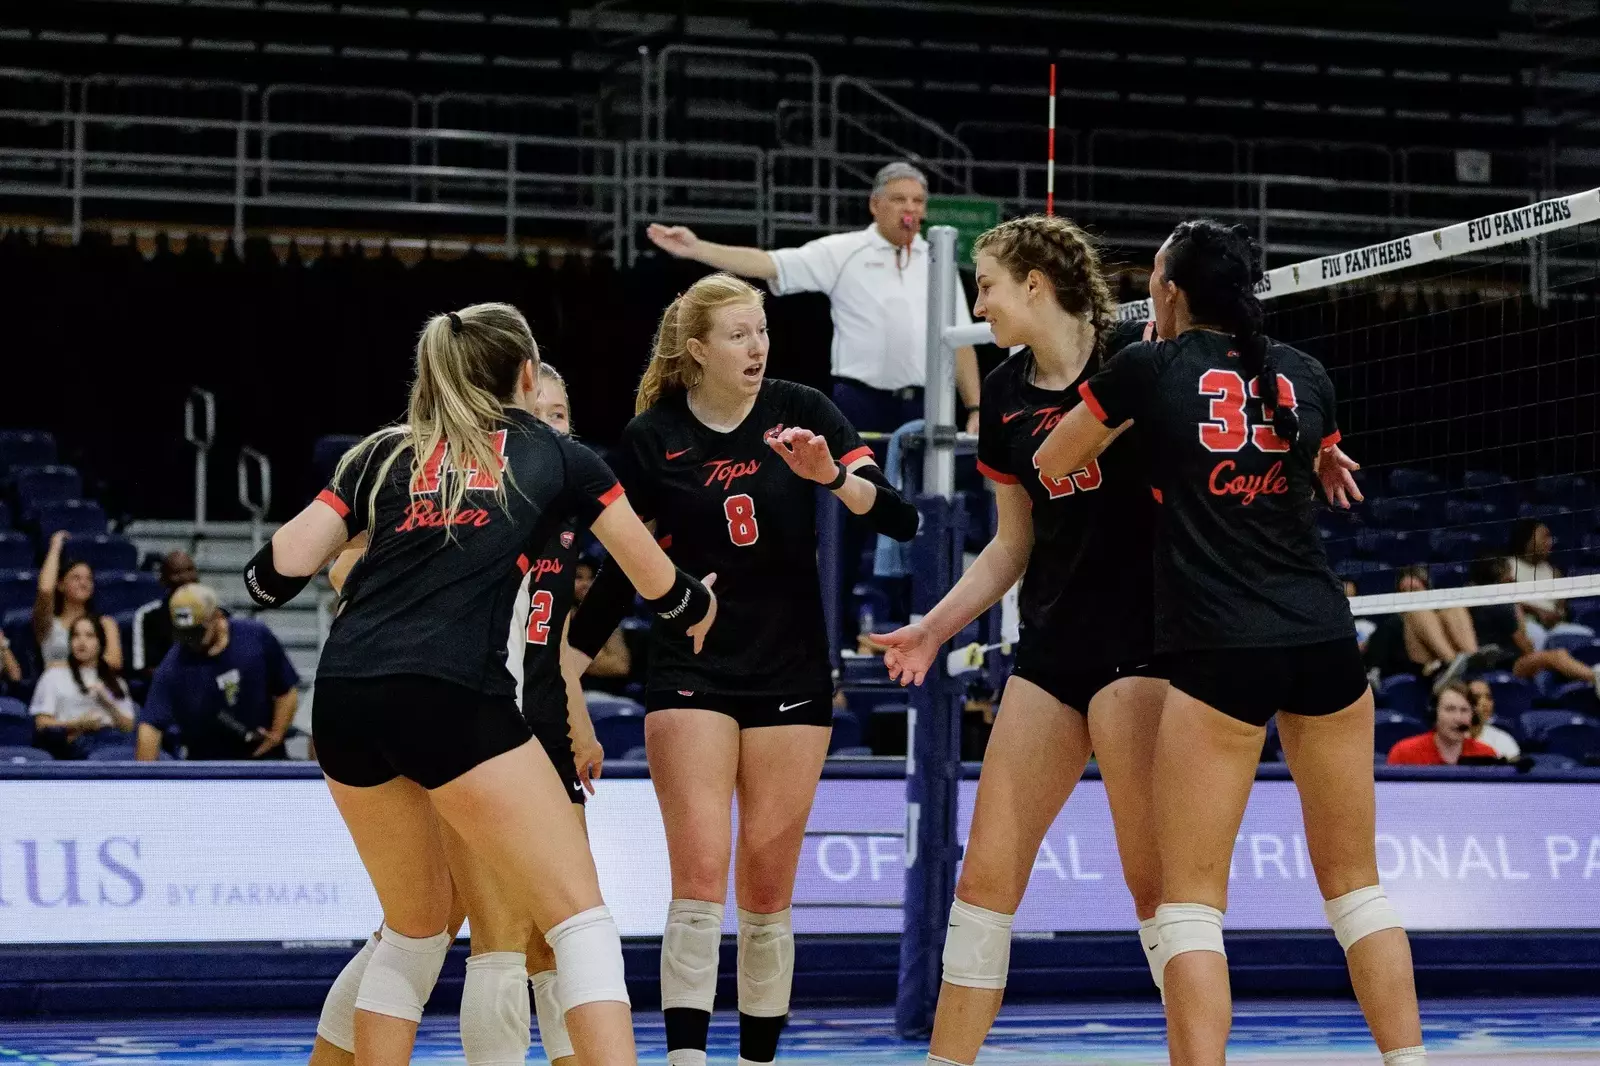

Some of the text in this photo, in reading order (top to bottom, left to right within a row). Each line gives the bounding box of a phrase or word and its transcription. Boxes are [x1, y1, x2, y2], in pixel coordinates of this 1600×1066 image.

[1467, 199, 1571, 243] FIU PANTHERS
[1321, 238, 1412, 279] FIU PANTHERS
[1031, 405, 1069, 436] To
[1199, 369, 1299, 452] 33
[702, 459, 761, 490] Tops
[1208, 459, 1288, 506] Coyle
[723, 493, 759, 547] 8
[531, 558, 563, 582] ops
[526, 589, 553, 645] 2
[0, 836, 338, 908] us BY FARMASI
